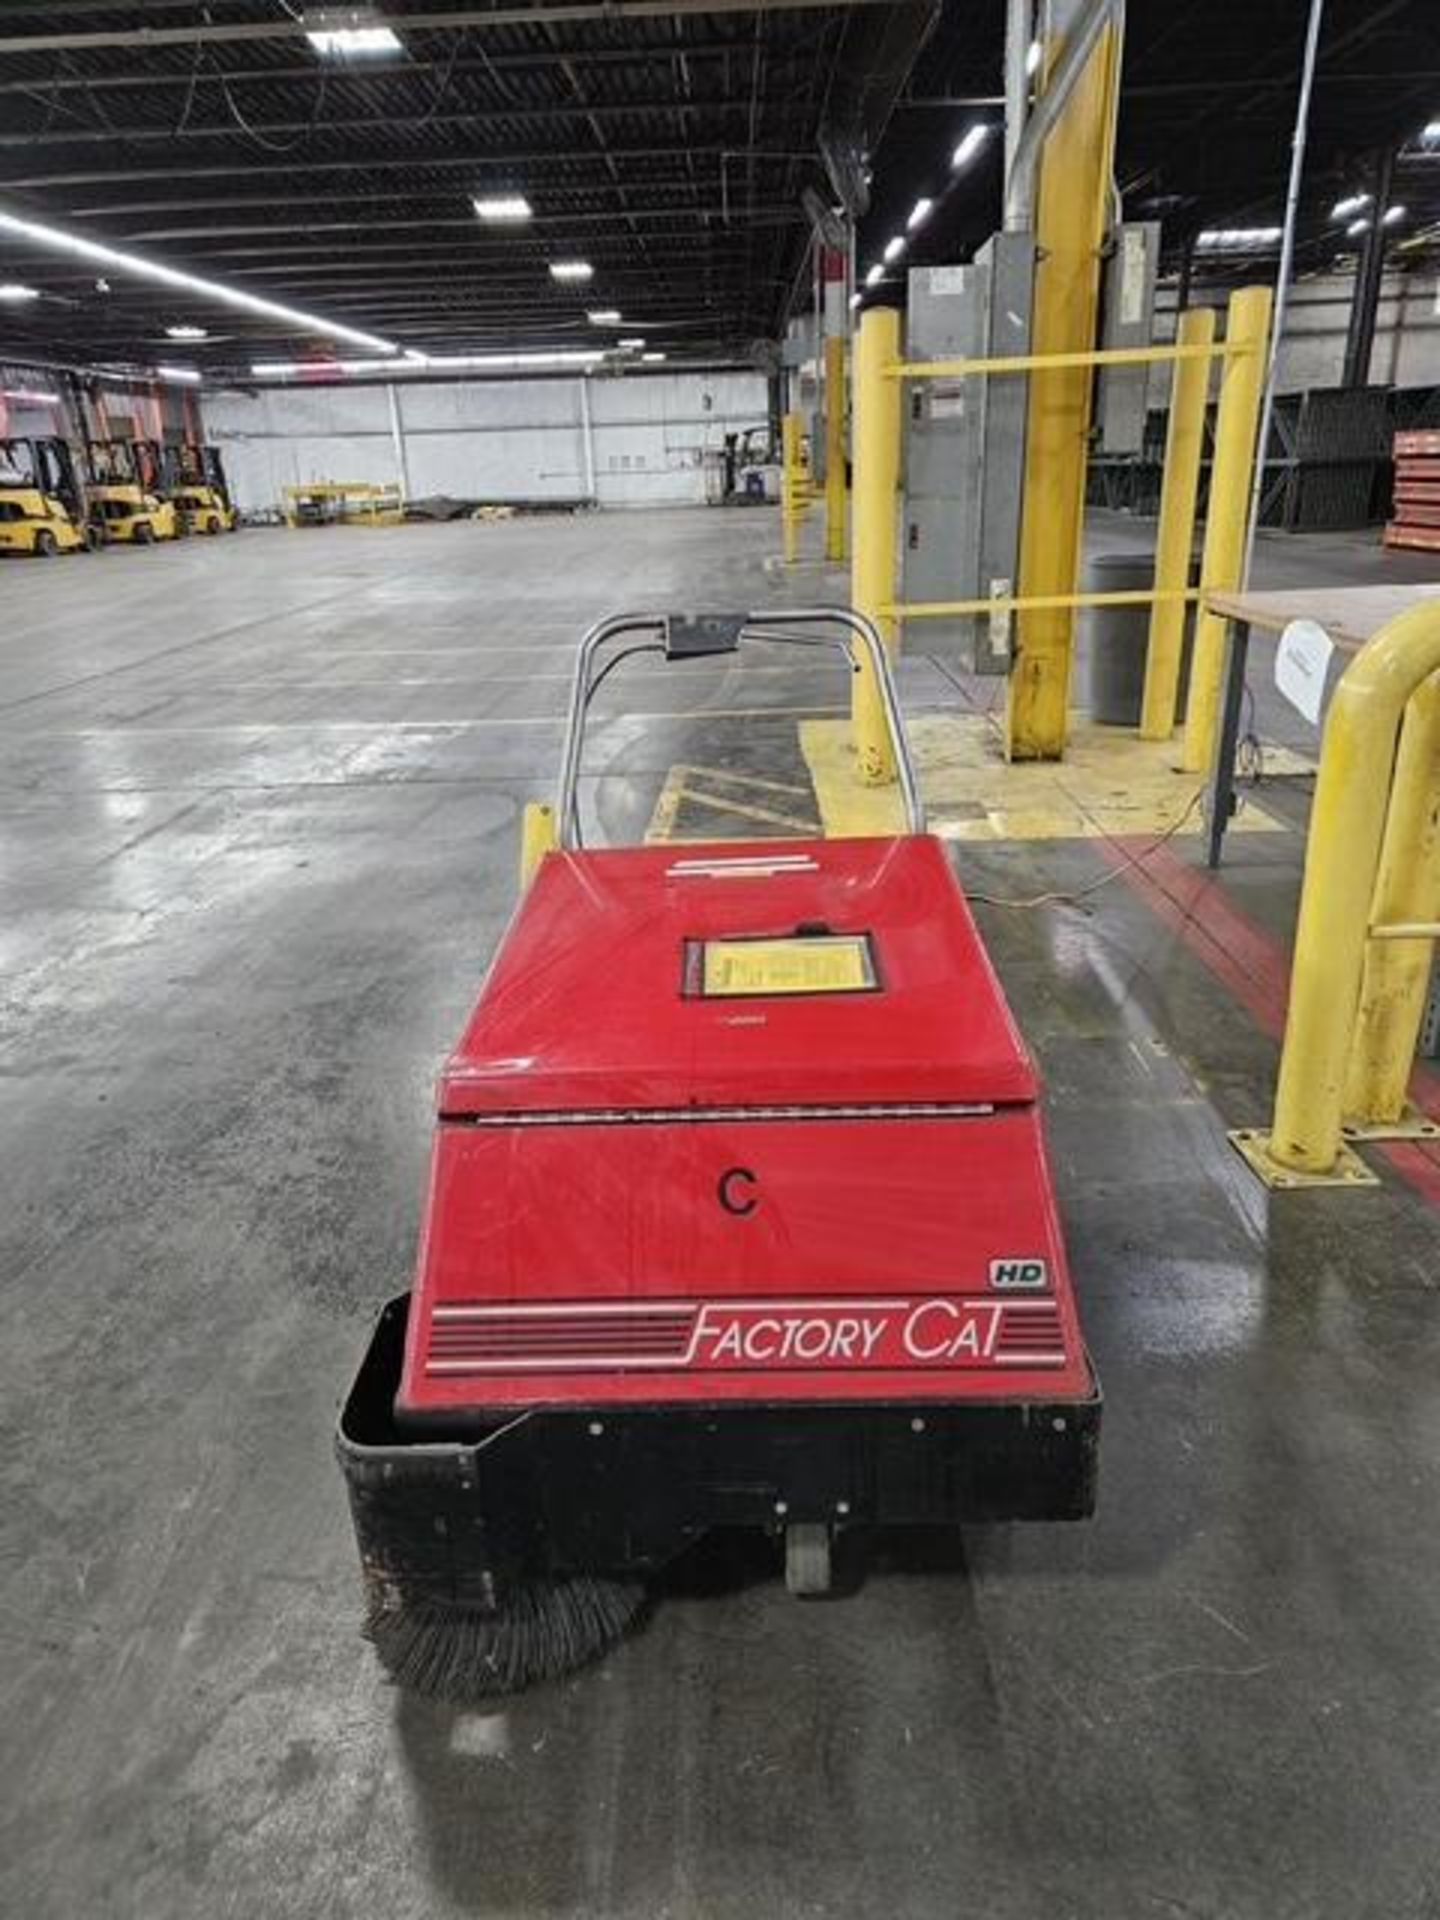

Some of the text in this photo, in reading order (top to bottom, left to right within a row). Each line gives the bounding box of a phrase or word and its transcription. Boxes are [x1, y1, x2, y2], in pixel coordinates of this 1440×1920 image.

[717, 1167, 757, 1216] C
[996, 1264, 1042, 1282] HD
[686, 1301, 1003, 1362] FACTORY CAT
